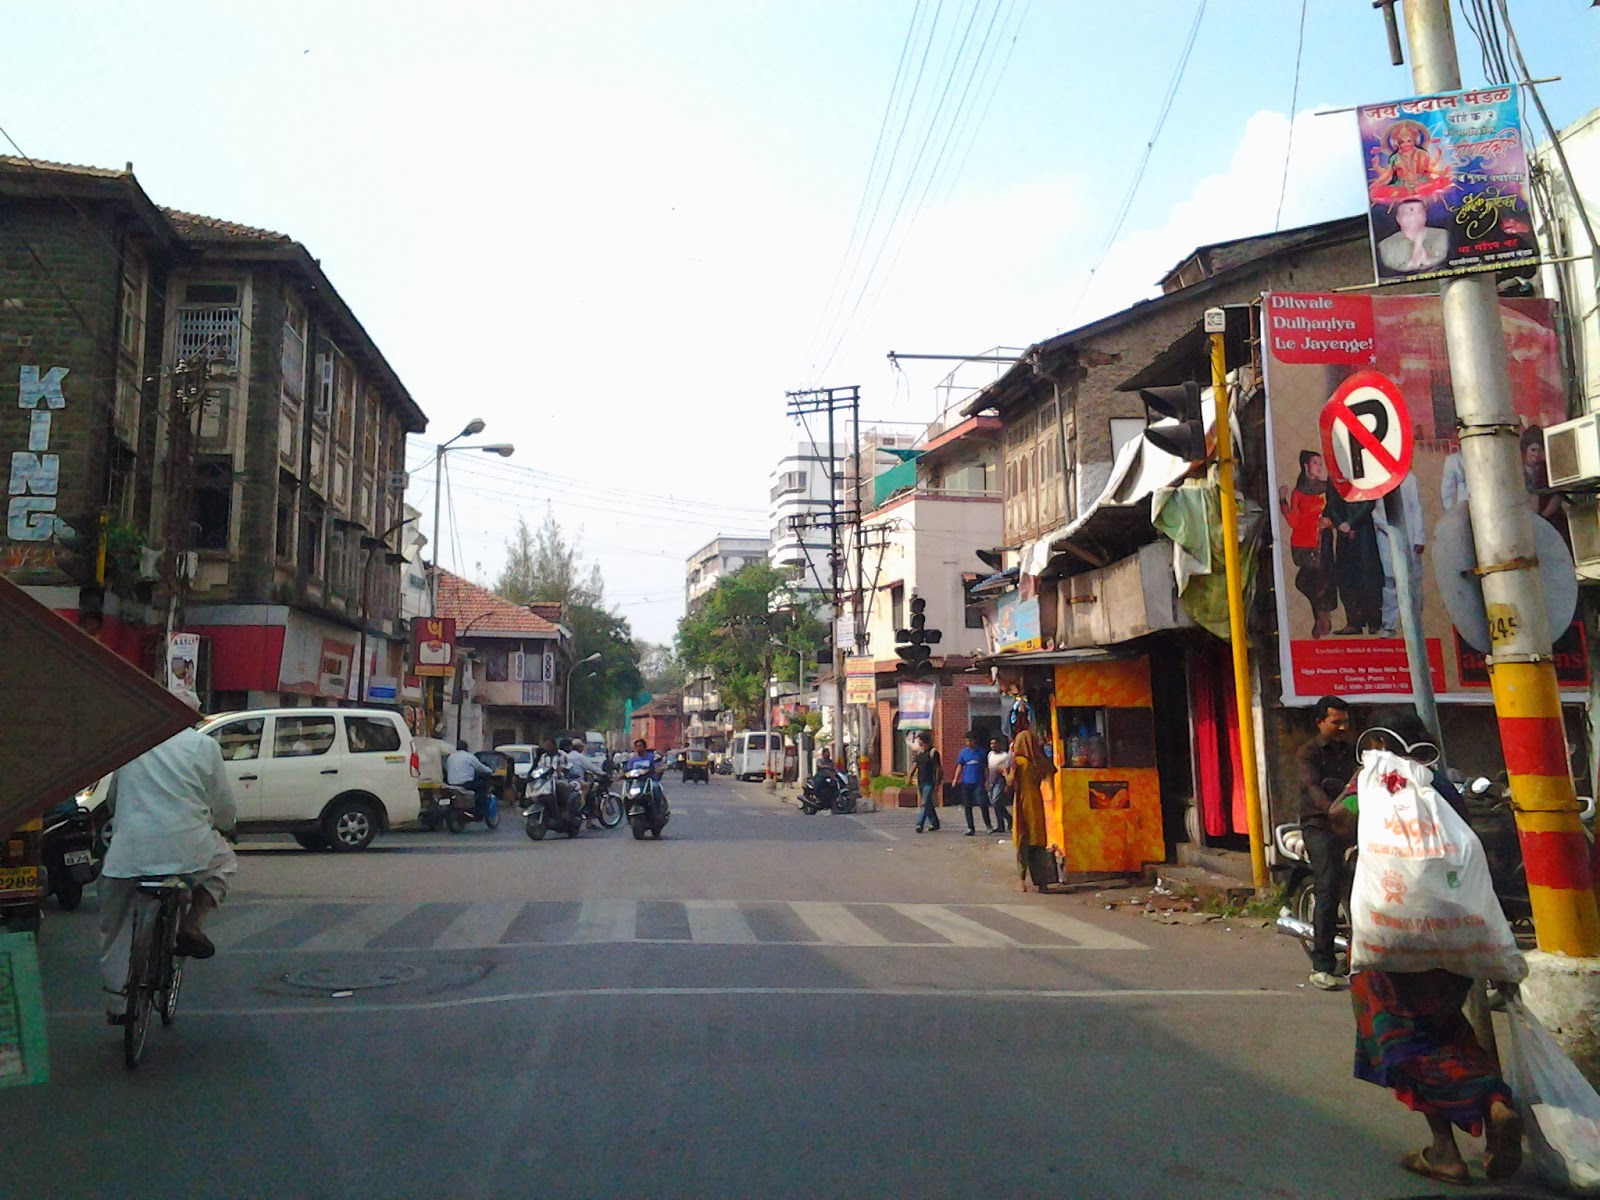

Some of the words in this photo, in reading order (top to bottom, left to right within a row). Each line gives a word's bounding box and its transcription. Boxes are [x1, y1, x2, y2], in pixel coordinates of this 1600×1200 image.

[1365, 104, 1398, 119] जय
[1403, 95, 1458, 113] जवान
[1463, 88, 1511, 106] मंडळ
[1271, 295, 1334, 309] Dilwale
[1273, 316, 1356, 332] Dulhaniya
[1275, 336, 1296, 350] Le
[1301, 336, 1374, 353] Jayenge!
[1347, 398, 1389, 480] P
